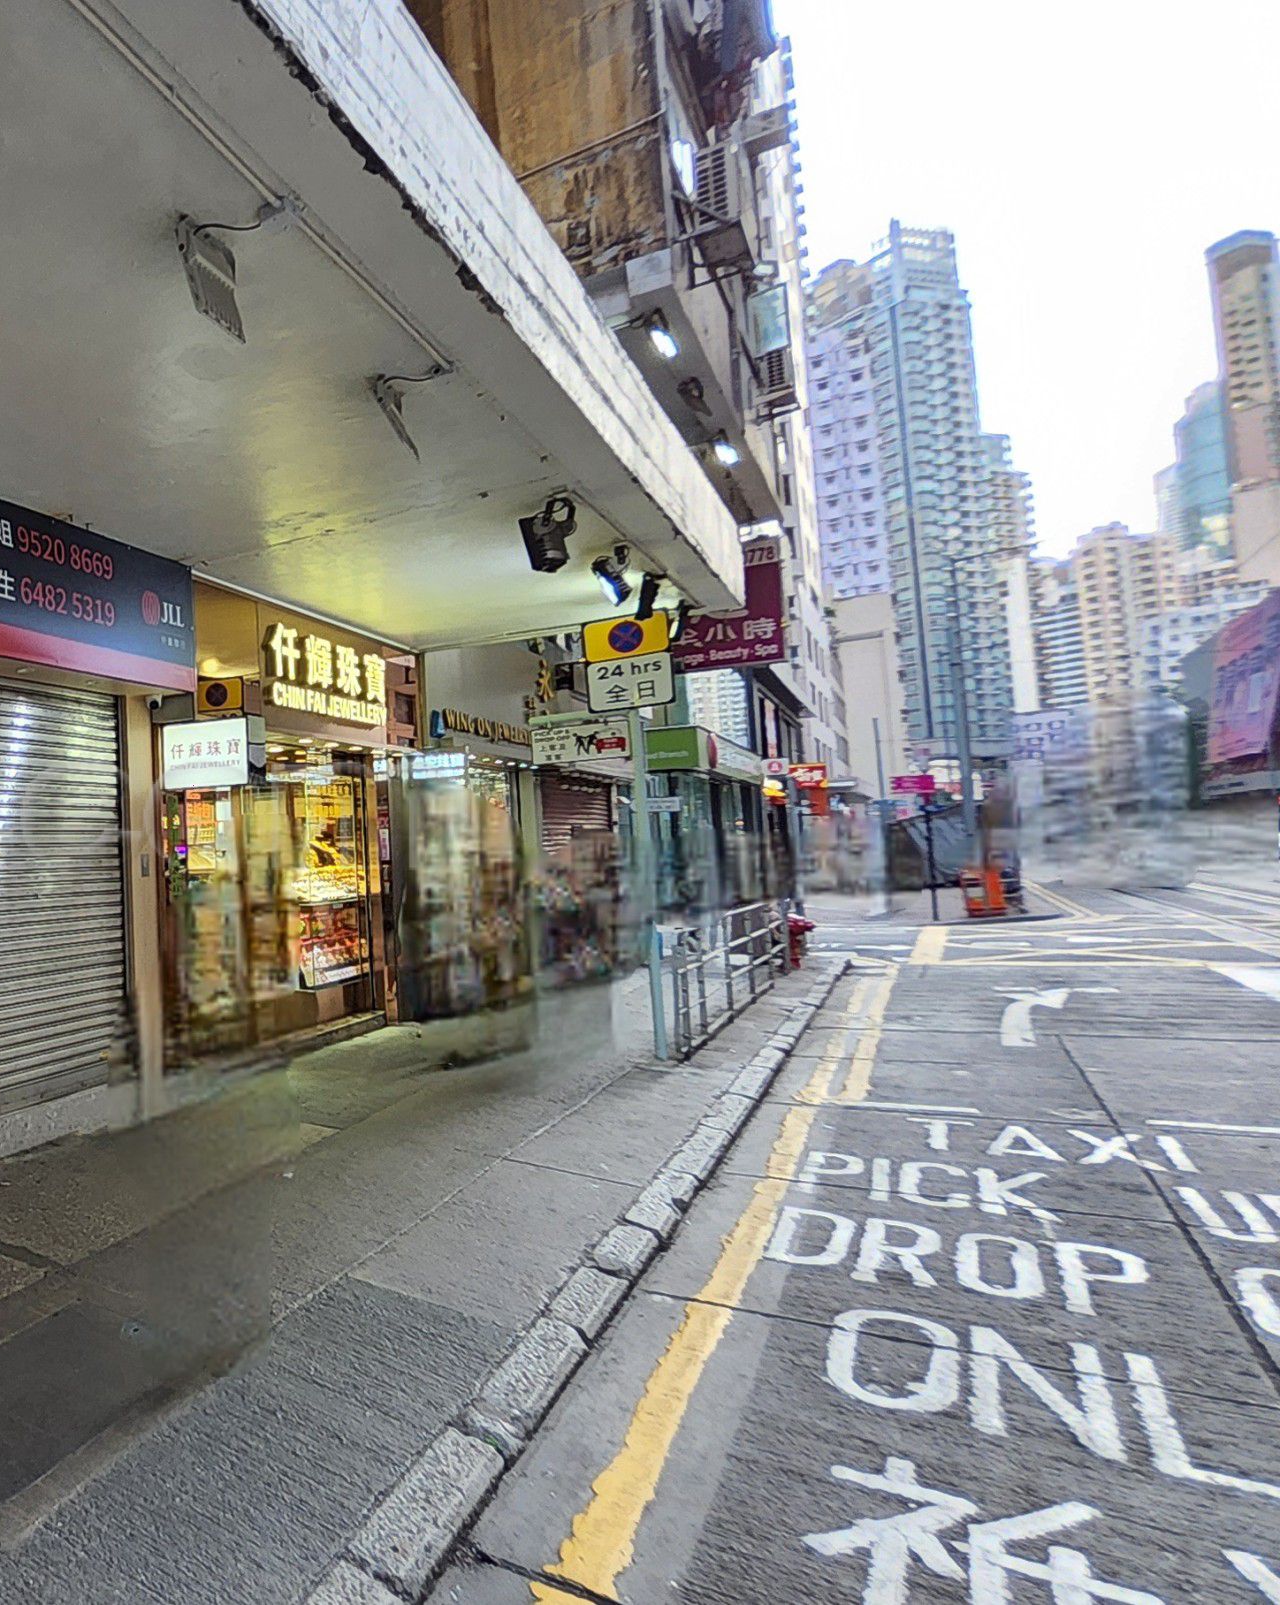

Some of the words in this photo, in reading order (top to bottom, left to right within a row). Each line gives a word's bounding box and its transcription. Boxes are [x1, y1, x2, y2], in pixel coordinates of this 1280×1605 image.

[17, 526, 65, 565] 9520
[70, 544, 113, 580] 8669
[20, 577, 67, 615] 6482
[72, 592, 115, 627] 5319
[161, 601, 184, 628] JLL
[269, 622, 387, 705] 仟輝珠寶
[597, 665, 625, 680] 24
[630, 661, 662, 676] hrs
[273, 681, 305, 710] CHIN
[307, 688, 326, 714] FAI
[328, 696, 388, 728] JEWELLERY
[605, 679, 655, 704] 全日
[444, 709, 475, 733] WING
[477, 717, 492, 738] ON
[170, 738, 241, 759] 仟輝珠寶
[906, 1117, 1201, 1174] TAXI
[795, 1151, 1064, 1224] PICK
[763, 1205, 1150, 1317] DROP
